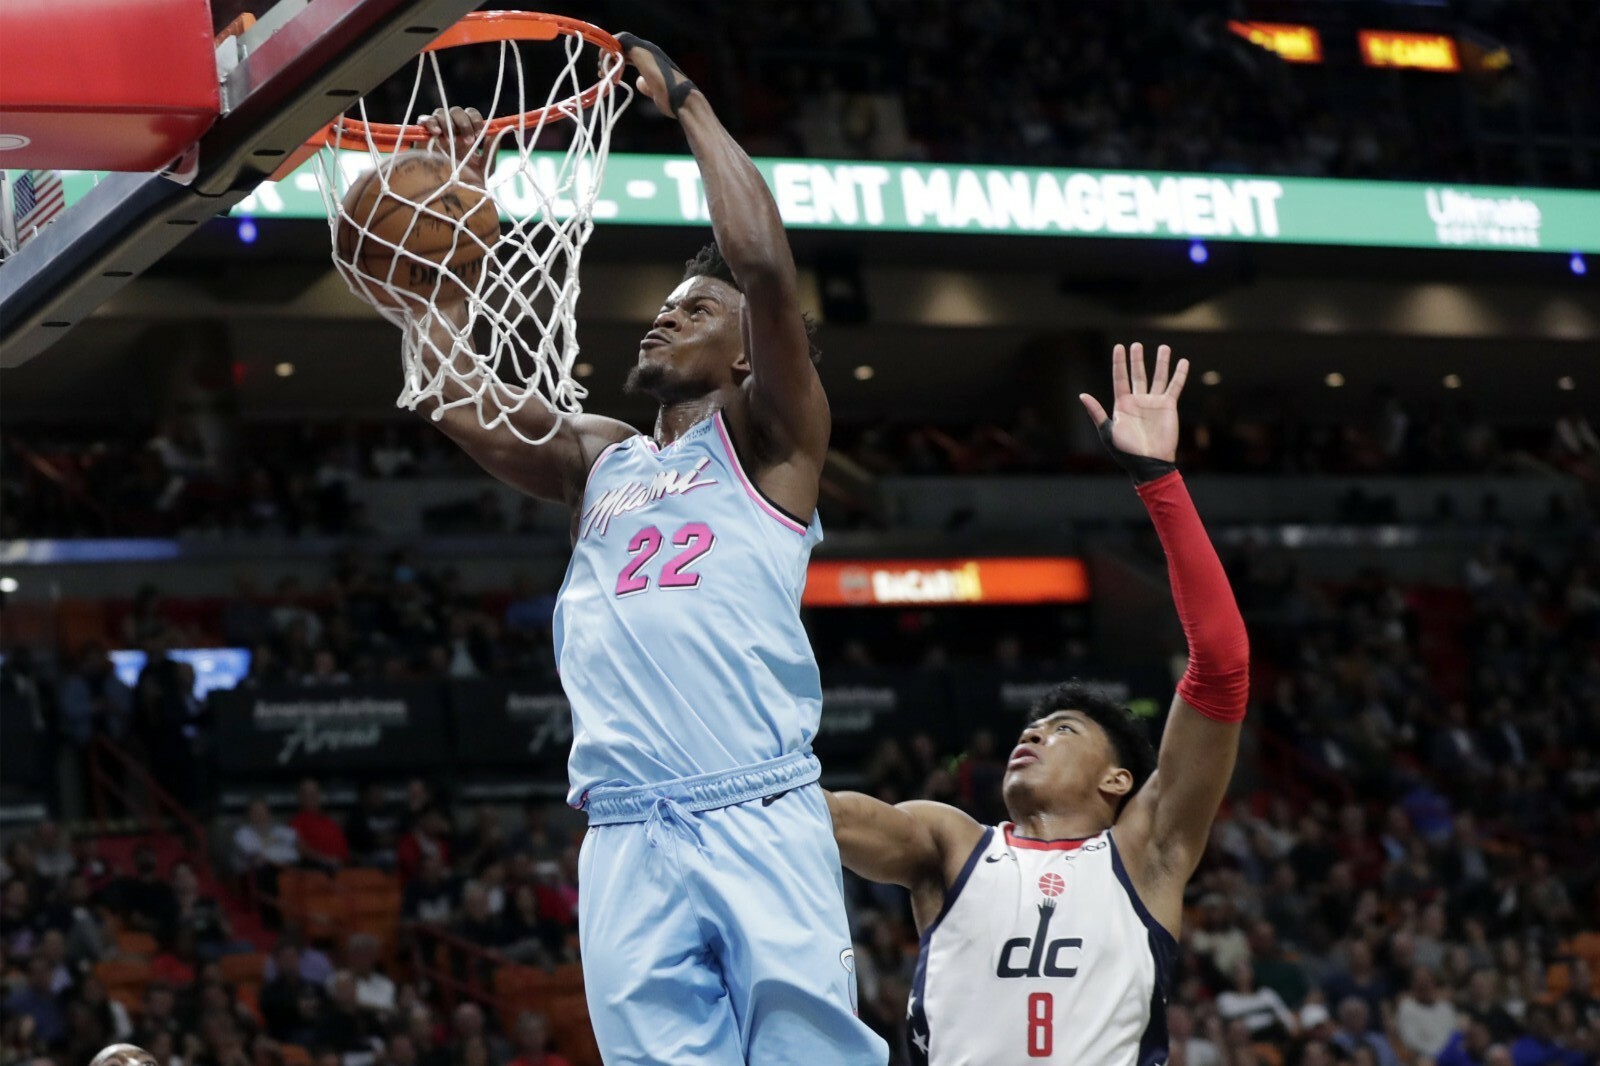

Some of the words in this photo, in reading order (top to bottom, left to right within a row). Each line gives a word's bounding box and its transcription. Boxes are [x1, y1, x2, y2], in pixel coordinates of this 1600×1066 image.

[664, 160, 889, 225] TENT
[902, 168, 1282, 237] MANAGEMENT
[583, 456, 719, 540] Miami
[615, 521, 718, 600] 22
[996, 898, 1083, 979] dc
[1027, 992, 1054, 1058] 8
